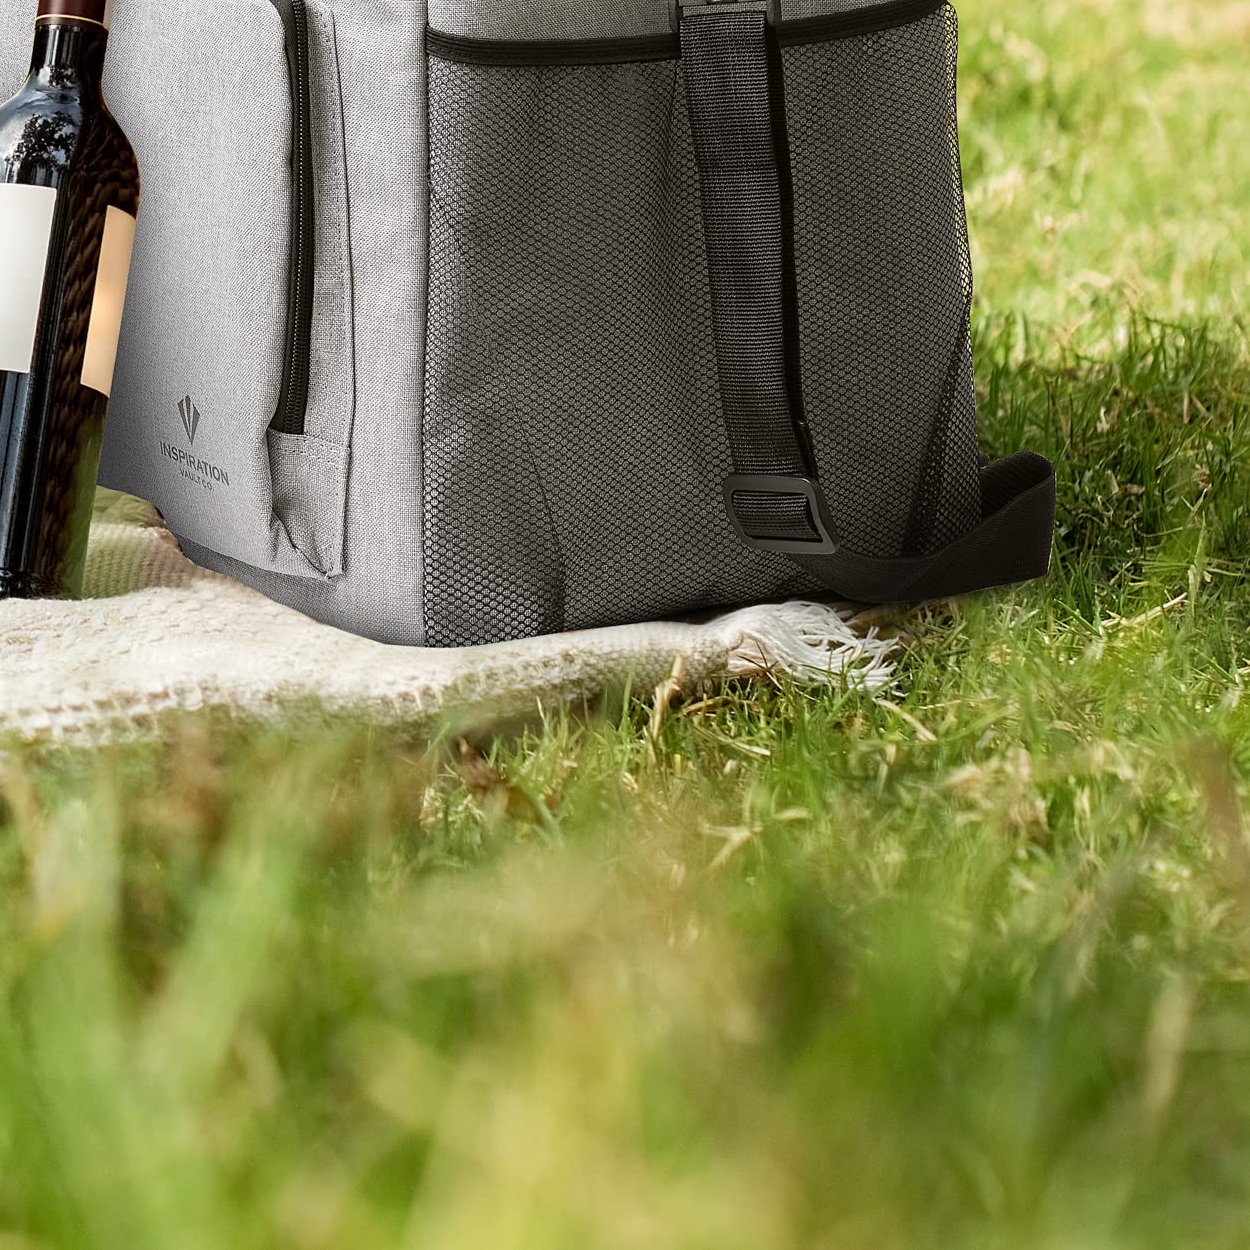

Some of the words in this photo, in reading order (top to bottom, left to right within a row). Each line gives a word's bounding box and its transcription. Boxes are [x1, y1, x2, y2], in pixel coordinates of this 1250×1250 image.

[159, 440, 230, 486] INSPIRATION
[179, 468, 201, 485] VAULT
[201, 479, 215, 491] CO.
